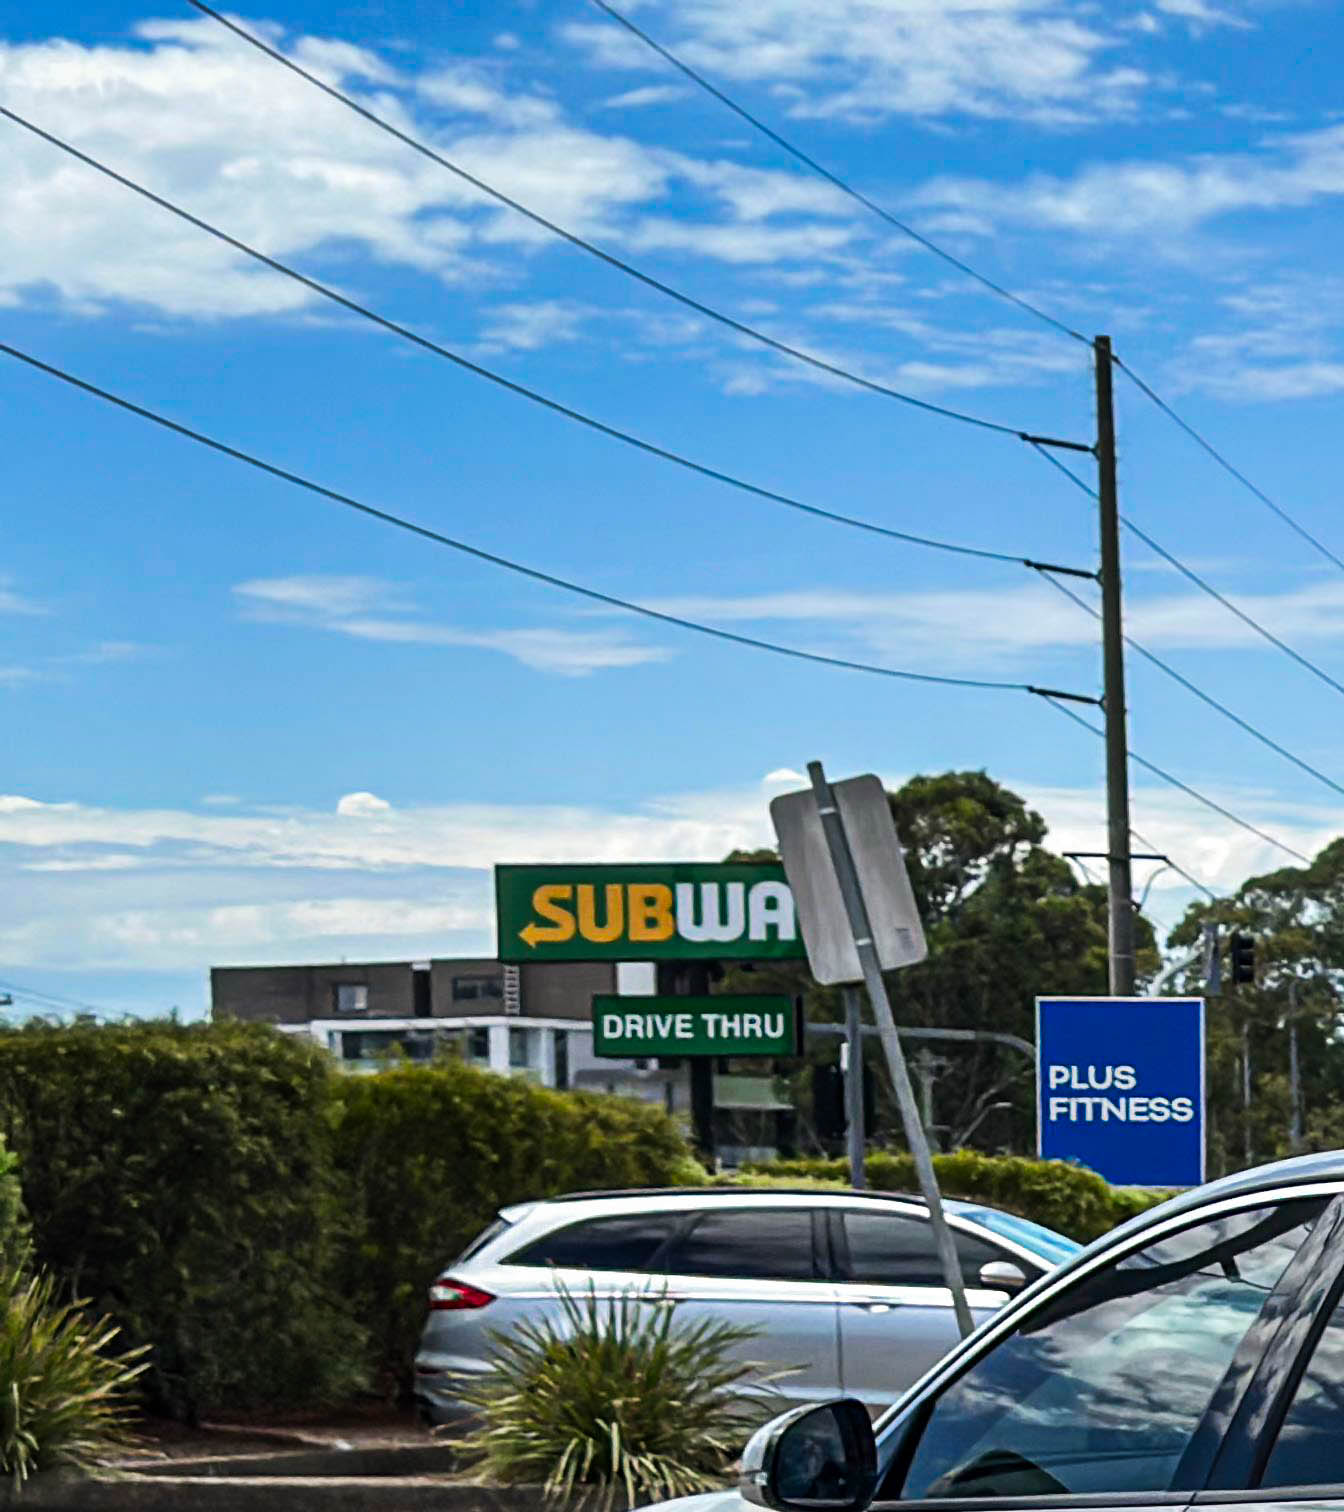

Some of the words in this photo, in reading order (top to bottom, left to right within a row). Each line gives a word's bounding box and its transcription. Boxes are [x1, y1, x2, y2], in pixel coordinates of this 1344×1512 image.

[518, 880, 797, 948] SUBWA
[602, 1014, 694, 1039] DRIVE
[701, 1013, 784, 1038] THRU
[1049, 1065, 1137, 1090] PLUS
[1049, 1097, 1194, 1122] FITNESS
